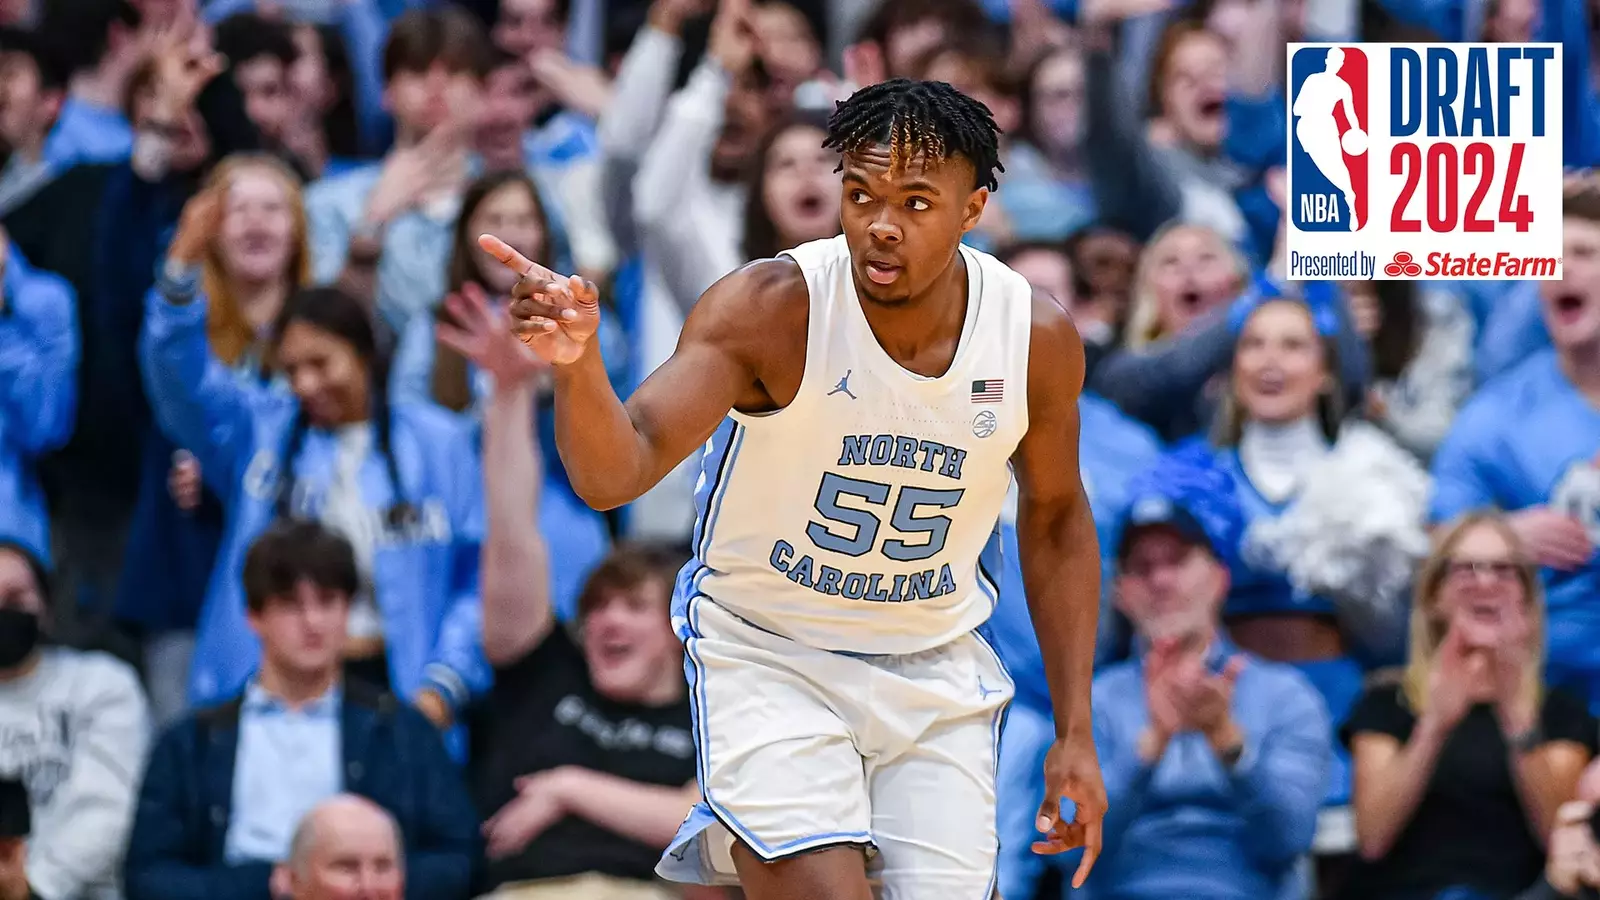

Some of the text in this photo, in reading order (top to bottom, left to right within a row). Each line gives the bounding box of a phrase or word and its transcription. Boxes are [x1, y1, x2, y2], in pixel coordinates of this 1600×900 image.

[837, 434, 967, 480] NORTH
[805, 471, 966, 562] 55
[769, 539, 956, 603] CAROLINA
